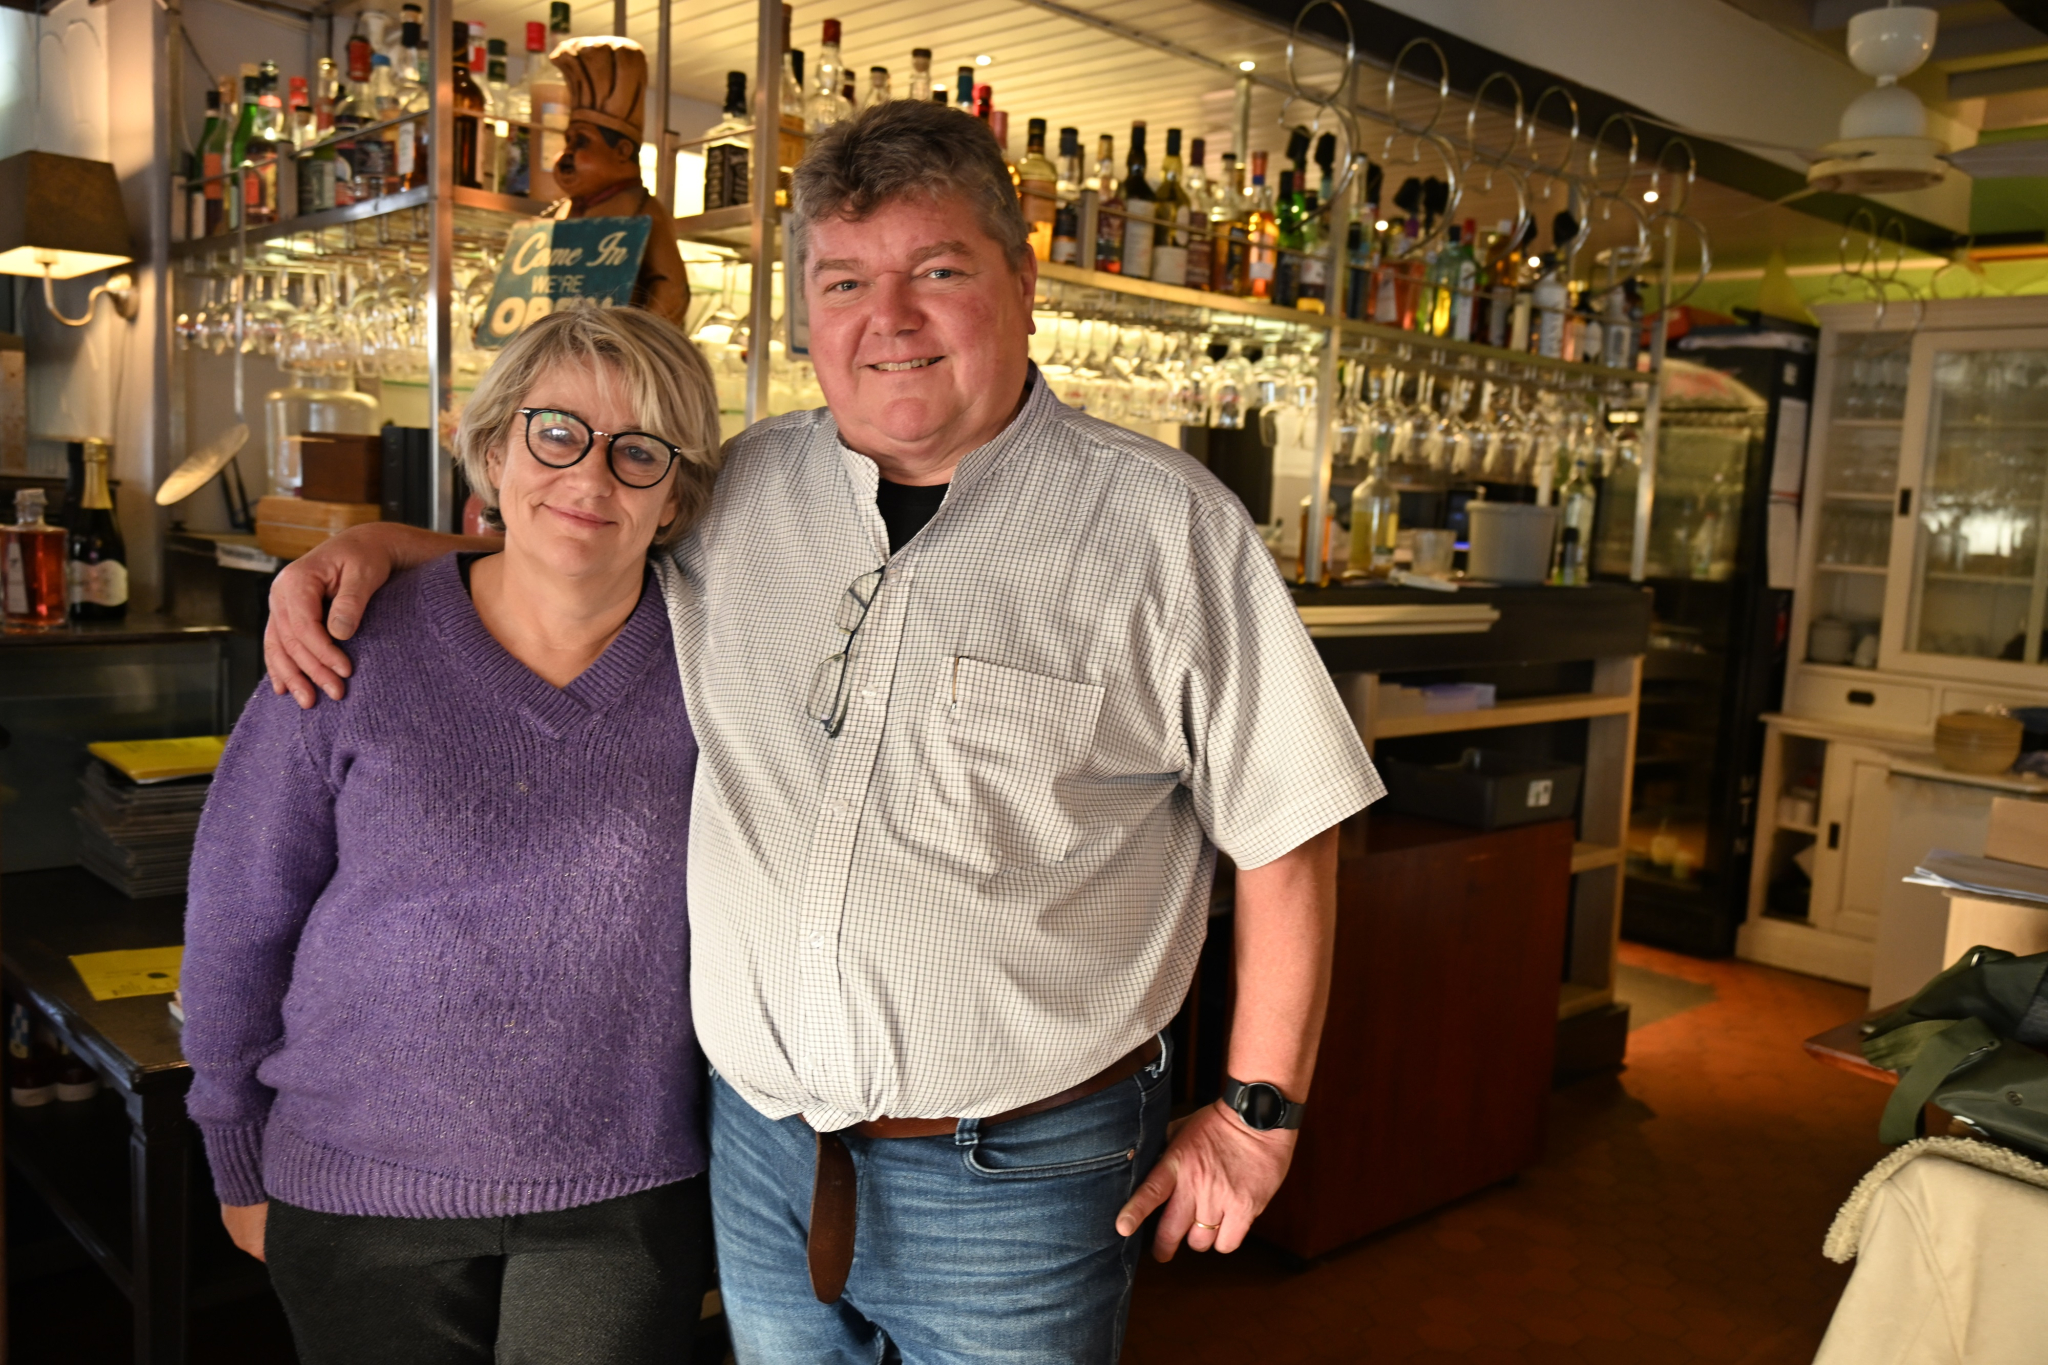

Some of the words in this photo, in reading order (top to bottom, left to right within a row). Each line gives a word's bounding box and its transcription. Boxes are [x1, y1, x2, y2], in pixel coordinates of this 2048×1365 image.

[511, 231, 583, 275] Come
[585, 231, 629, 267] In
[531, 274, 585, 294] WE'RE
